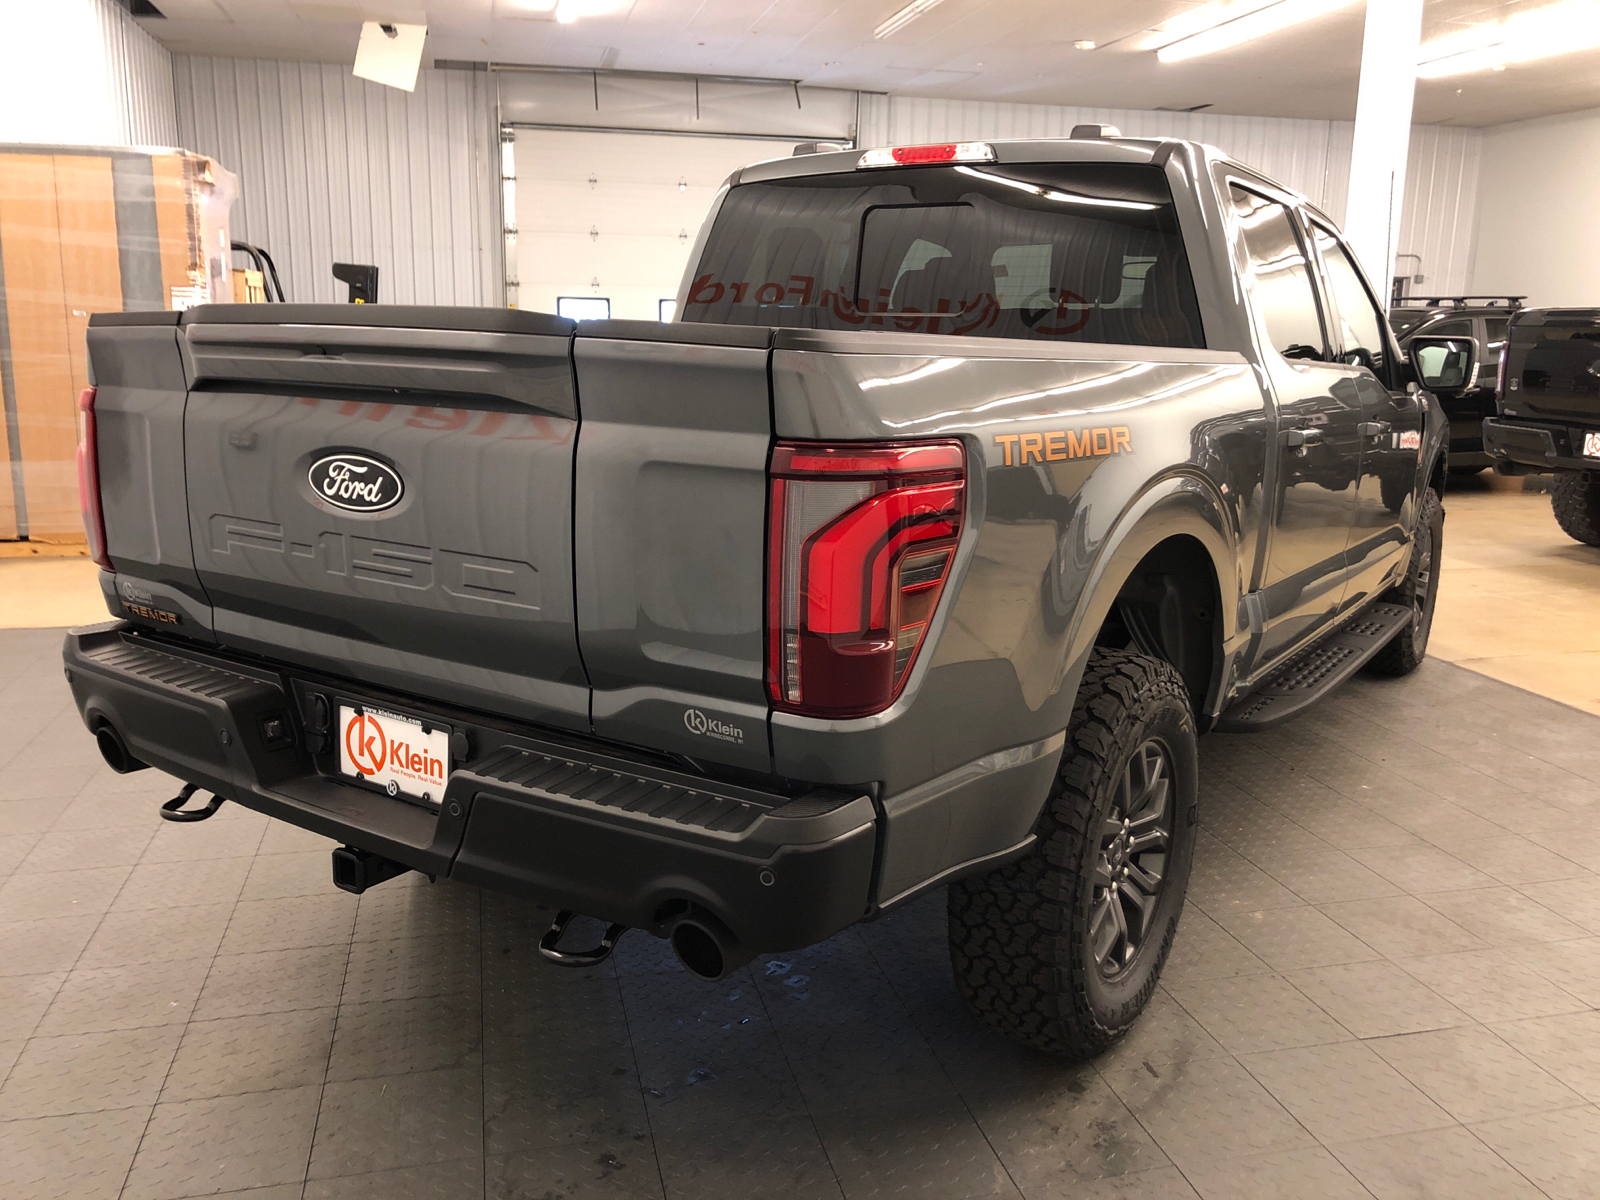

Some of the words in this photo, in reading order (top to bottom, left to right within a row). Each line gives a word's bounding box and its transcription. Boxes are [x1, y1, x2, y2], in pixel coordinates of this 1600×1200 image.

[995, 426, 1132, 466] TREMOR
[323, 461, 383, 502] Ford
[209, 513, 541, 610] F-150
[122, 602, 178, 624] TREMOR
[362, 706, 421, 726] www.kleinauto.com
[708, 719, 743, 737] Klein
[390, 739, 443, 779] Klein
[390, 766, 399, 775] Real
[418, 774, 427, 782] Real
